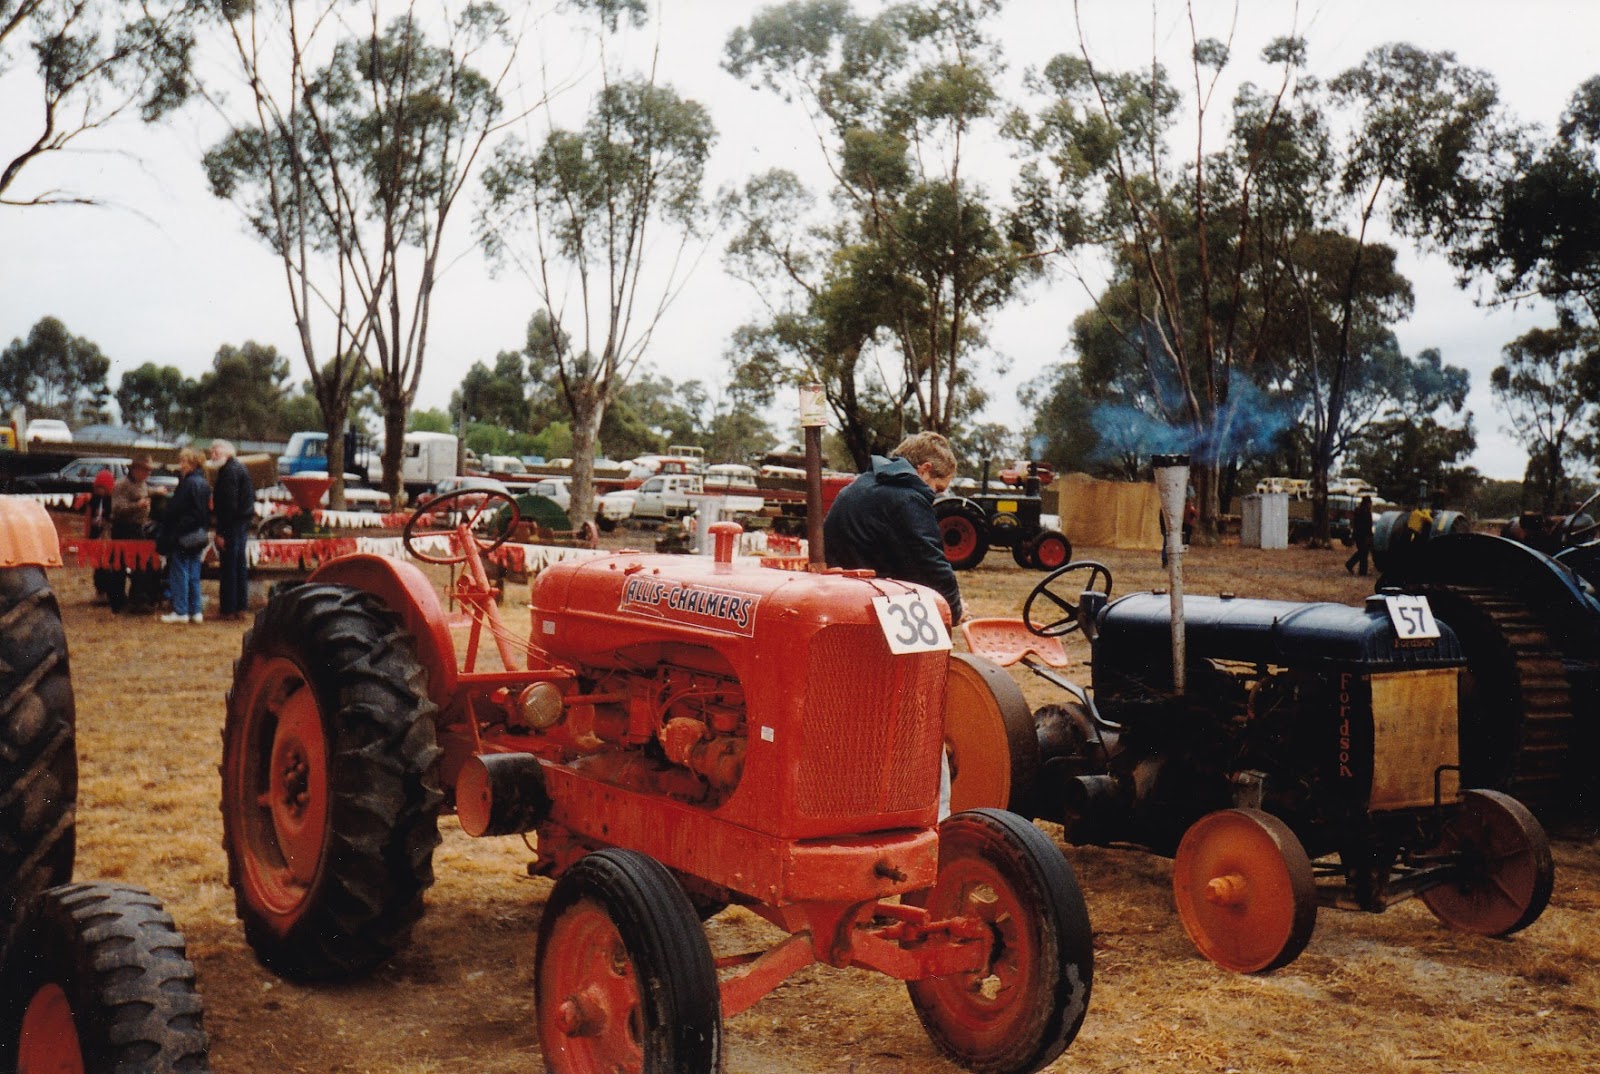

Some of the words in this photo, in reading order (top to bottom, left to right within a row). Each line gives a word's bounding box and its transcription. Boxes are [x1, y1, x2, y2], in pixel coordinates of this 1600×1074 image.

[625, 580, 752, 628] ALLIS-CHALMERS
[887, 601, 939, 646] 38
[1398, 606, 1426, 635] 57
[1339, 672, 1353, 778] Fordson
